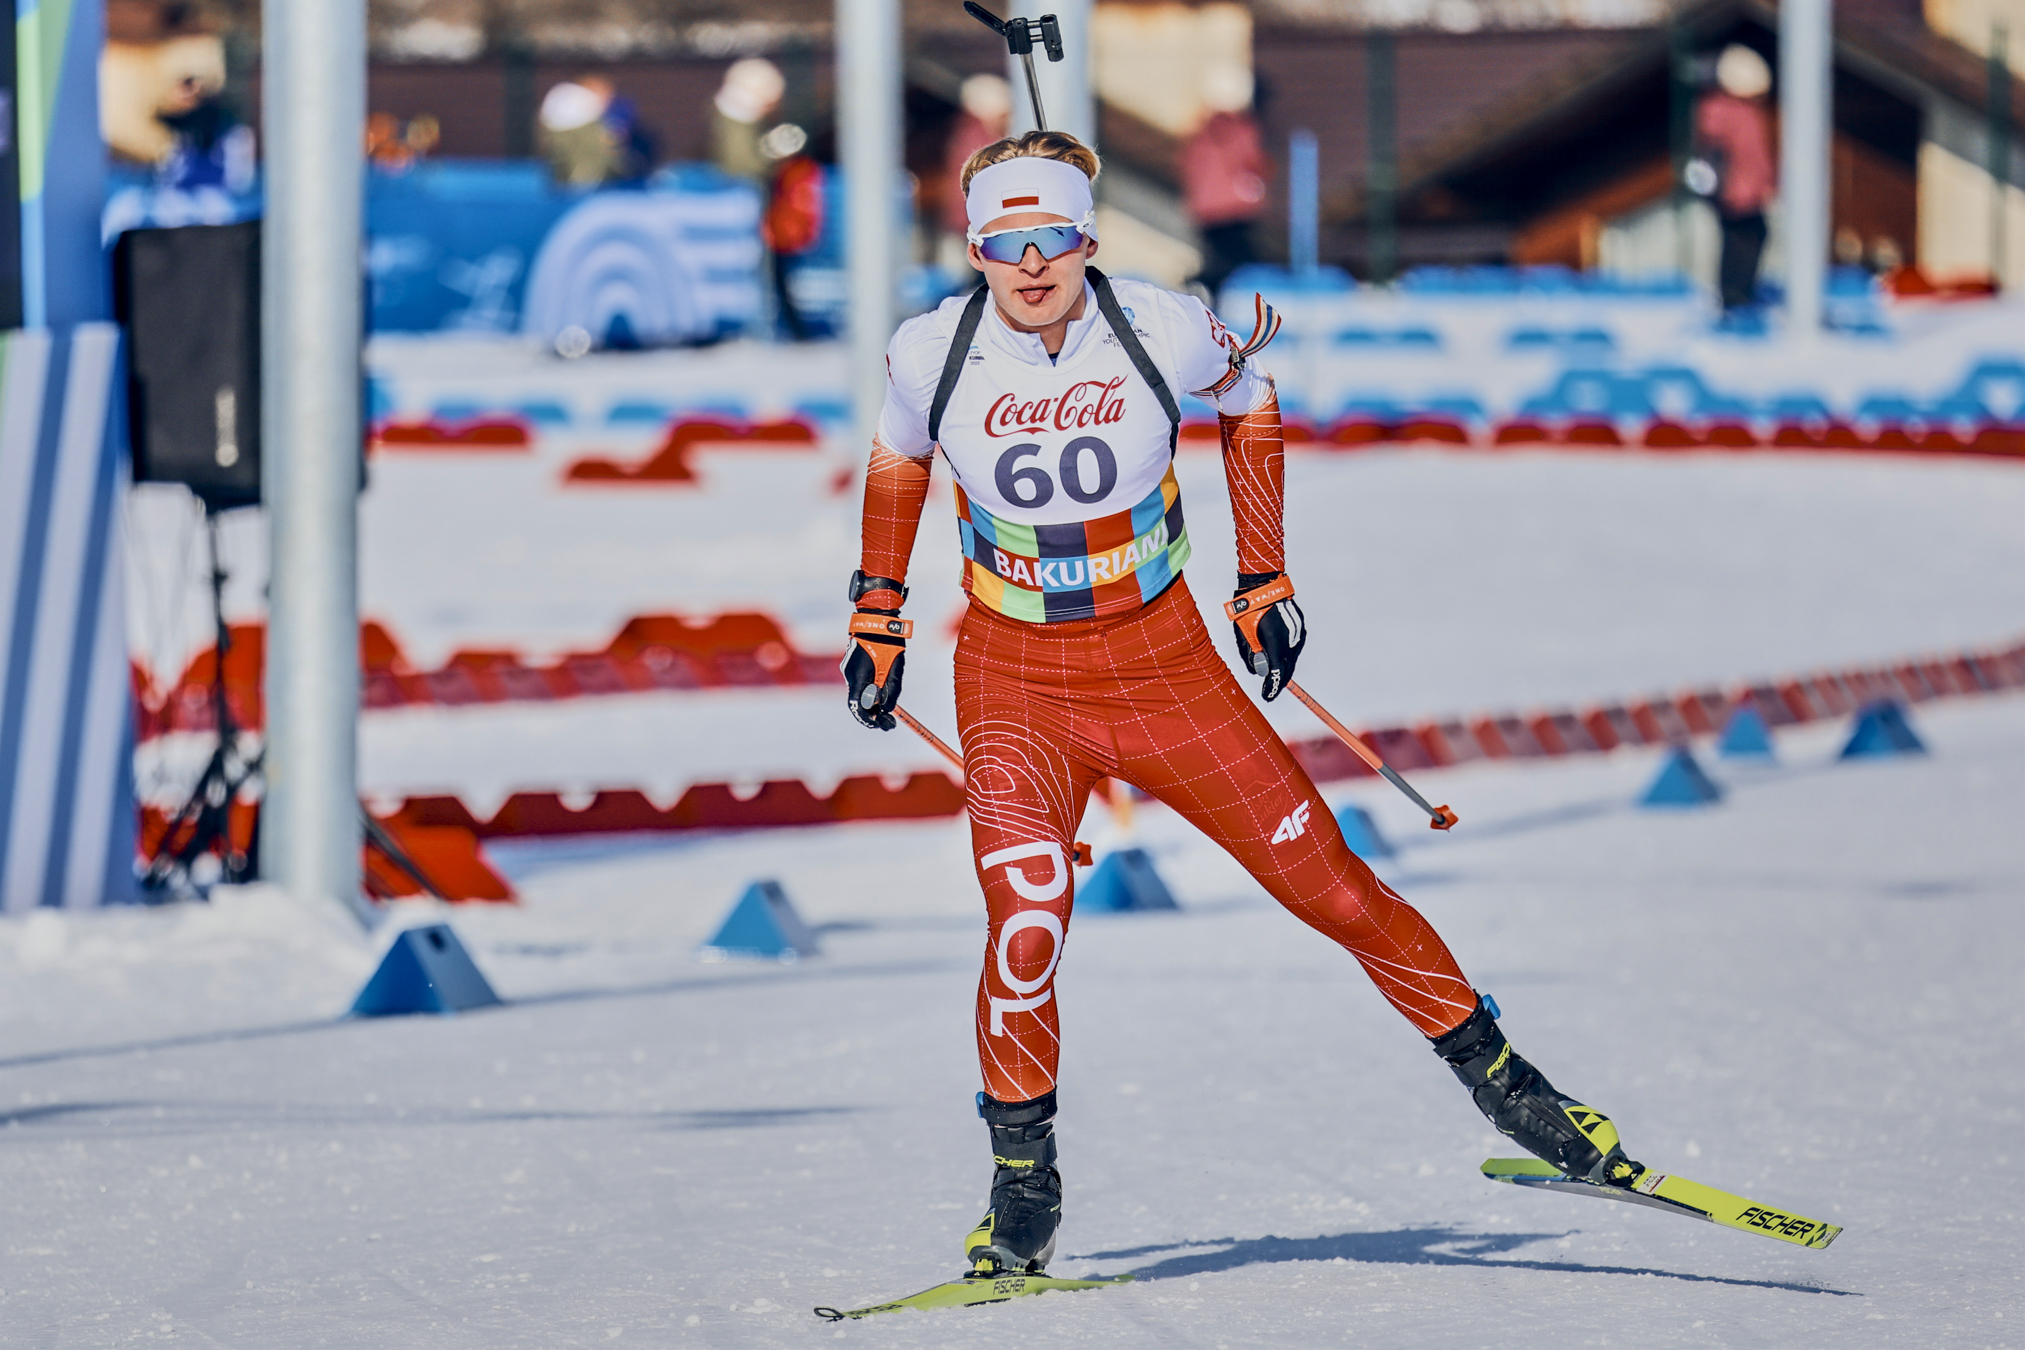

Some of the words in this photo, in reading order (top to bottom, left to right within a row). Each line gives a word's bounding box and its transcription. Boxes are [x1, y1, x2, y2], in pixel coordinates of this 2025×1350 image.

[984, 373, 1129, 438] Coca-Cola
[994, 436, 1118, 509] 60
[993, 520, 1169, 588] BAKURIANI
[1271, 799, 1310, 845] 4F
[981, 841, 1069, 1038] POL
[993, 1154, 1035, 1168] CHER
[1735, 1206, 1816, 1240] FISCHER
[993, 1278, 1026, 1296] FISCHER
